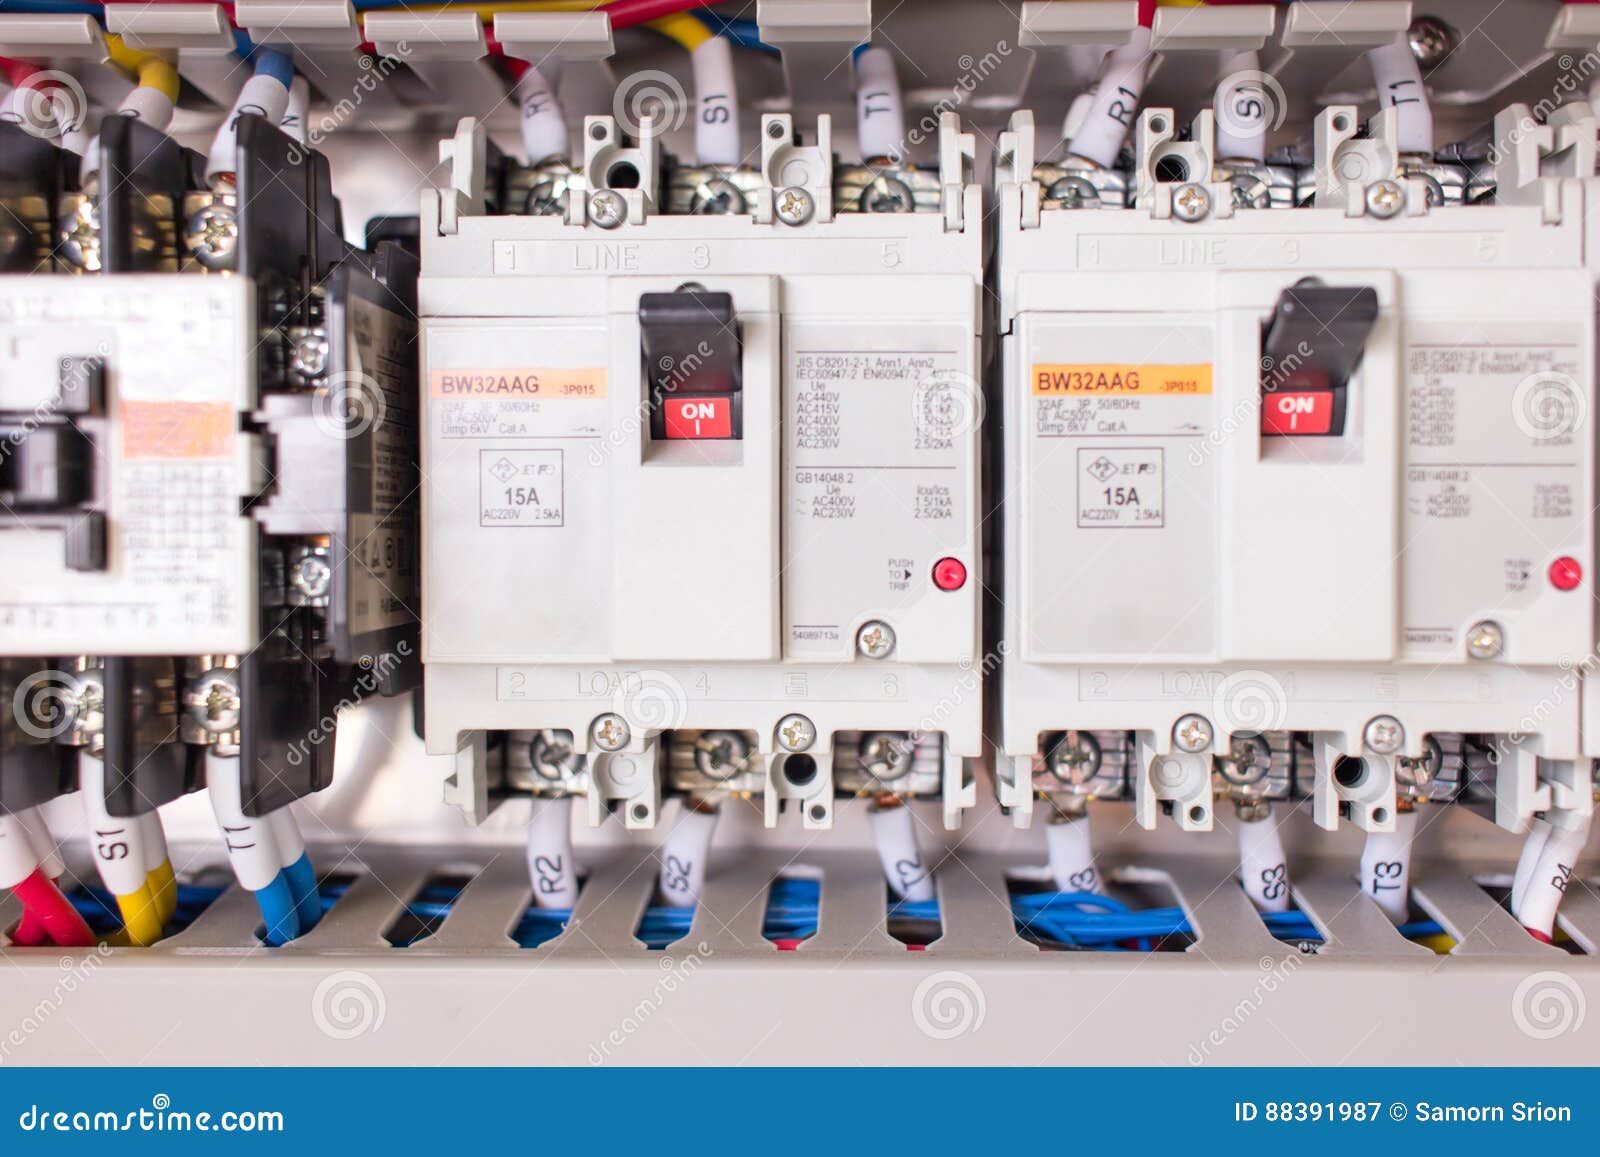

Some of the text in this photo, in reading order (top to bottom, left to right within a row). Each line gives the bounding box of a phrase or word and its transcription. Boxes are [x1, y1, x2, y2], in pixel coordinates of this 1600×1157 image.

[1235, 86, 1261, 119] S1
[1390, 80, 1419, 106] T1
[703, 95, 729, 123] S1
[864, 92, 891, 119] T1
[1107, 86, 1136, 127] R1
[575, 244, 640, 270] LINE
[693, 244, 711, 270] 3
[881, 241, 902, 269] 5
[1160, 239, 1227, 265] LINE
[441, 375, 540, 394] BW32AAG
[1037, 372, 1140, 391] BW32AAG
[797, 392, 840, 402] AC440V
[1278, 396, 1315, 414] ON
[681, 402, 715, 420] ON
[797, 404, 840, 414] AC415V
[797, 416, 840, 425] AC400V
[797, 427, 840, 437] AC380V
[797, 439, 840, 449] AC230V
[795, 473, 854, 484] GB14048.2
[505, 487, 540, 506] 15A
[812, 496, 856, 507] AC400V
[1104, 487, 1140, 506] 15A
[483, 508, 521, 520] AC220V
[812, 508, 856, 518] AC230V
[1081, 509, 1120, 521] AC220V
[888, 559, 914, 568] PUSH
[510, 671, 899, 697] 2 LOAD 4 6
[96, 828, 129, 861] S1
[223, 826, 257, 853] T1
[534, 854, 567, 894] R2
[667, 855, 692, 892] S2
[895, 860, 926, 892] T2
[1261, 863, 1287, 900] S3
[1373, 861, 1403, 894] T3
